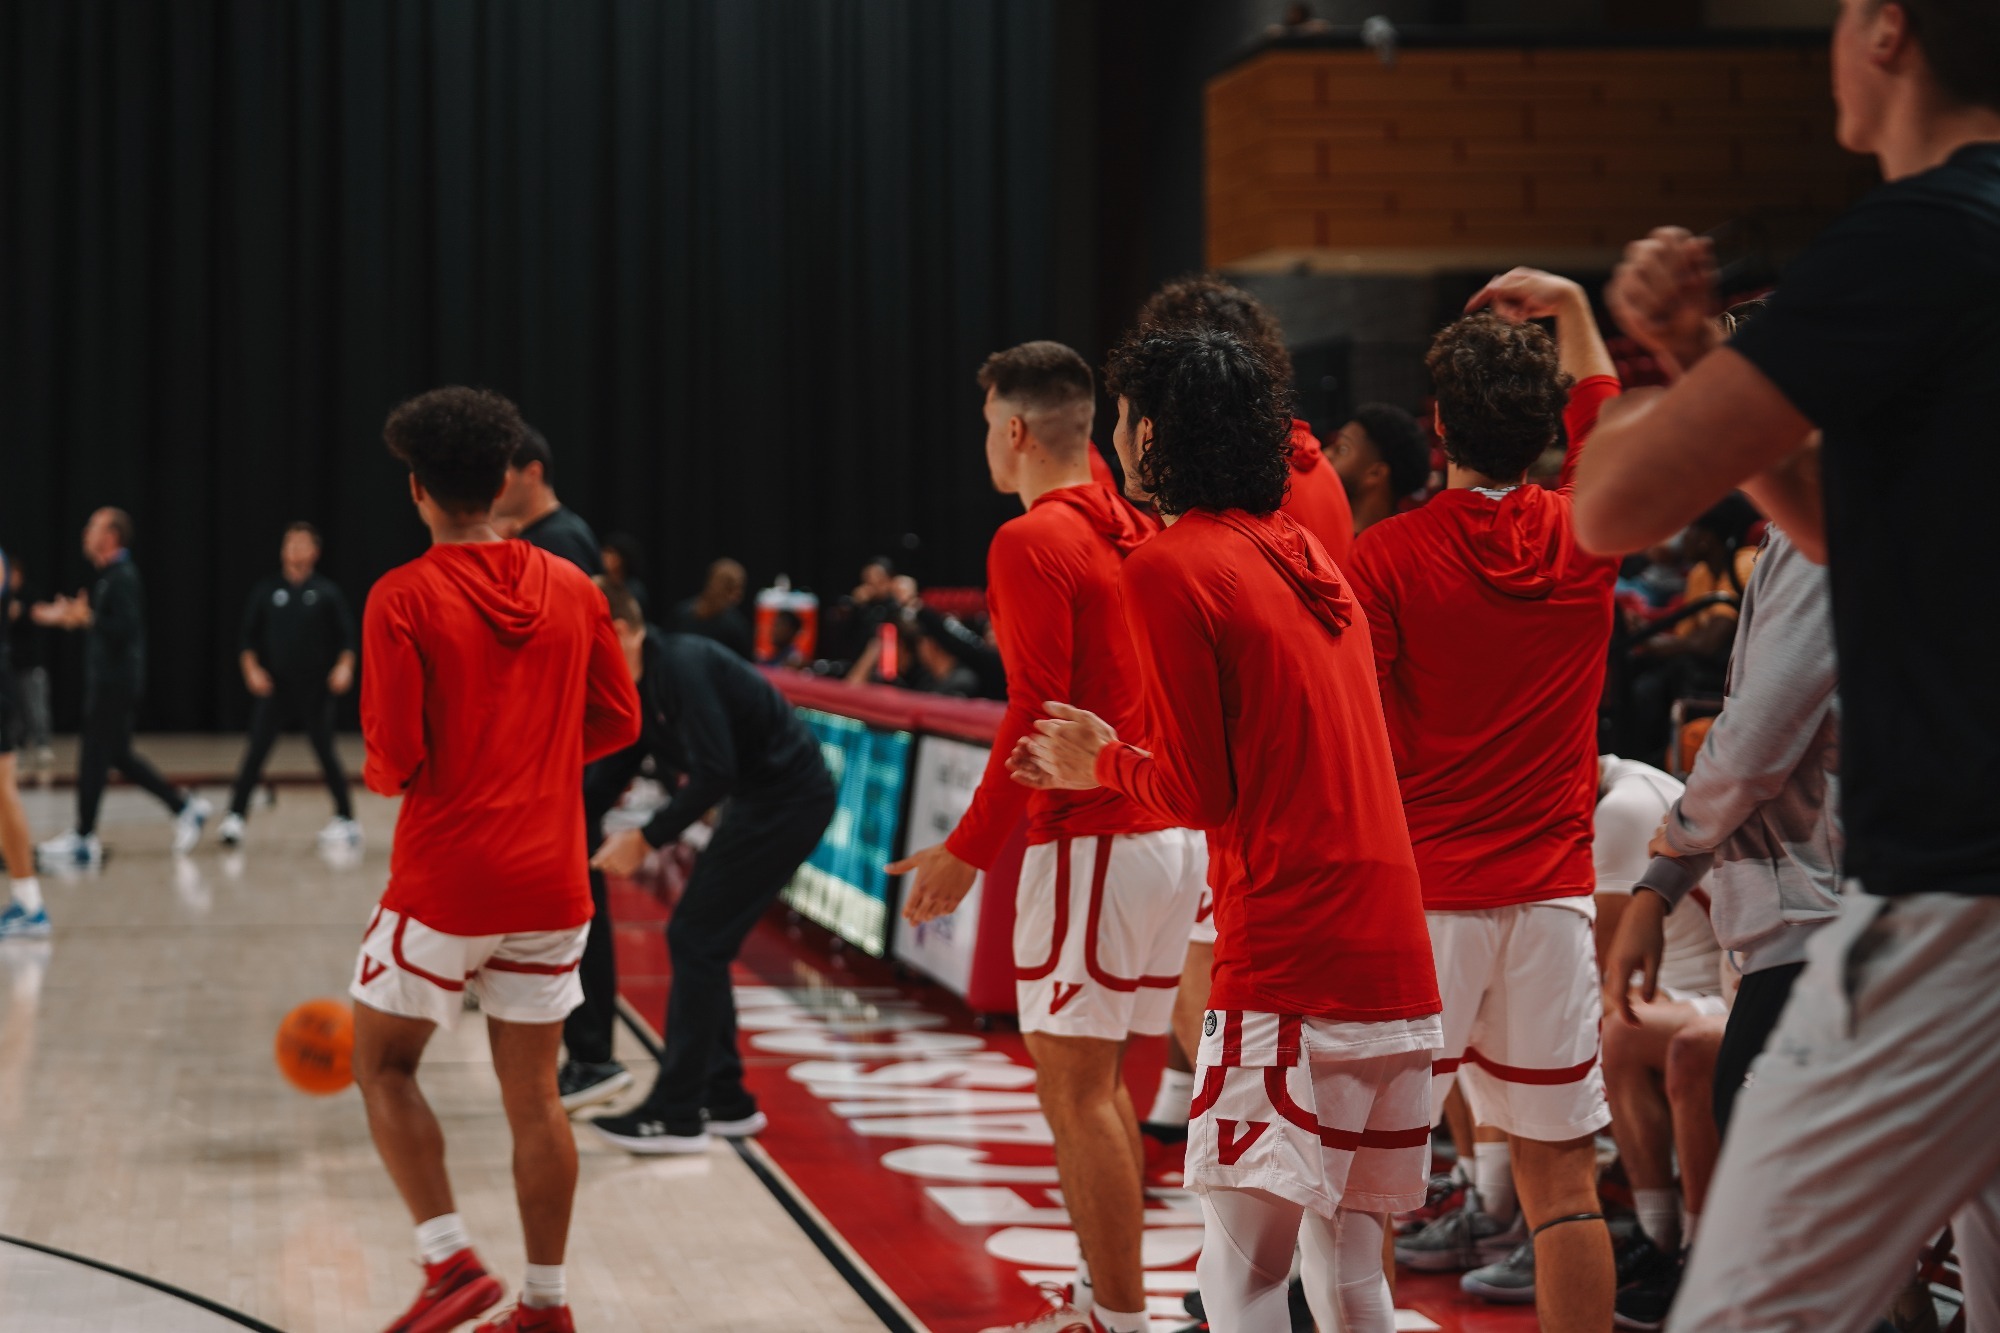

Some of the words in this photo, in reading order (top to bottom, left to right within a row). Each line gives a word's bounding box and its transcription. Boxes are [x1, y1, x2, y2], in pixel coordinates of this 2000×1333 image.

[360, 952, 388, 986] V
[1048, 981, 1084, 1015] V
[1216, 1118, 1270, 1166] V
